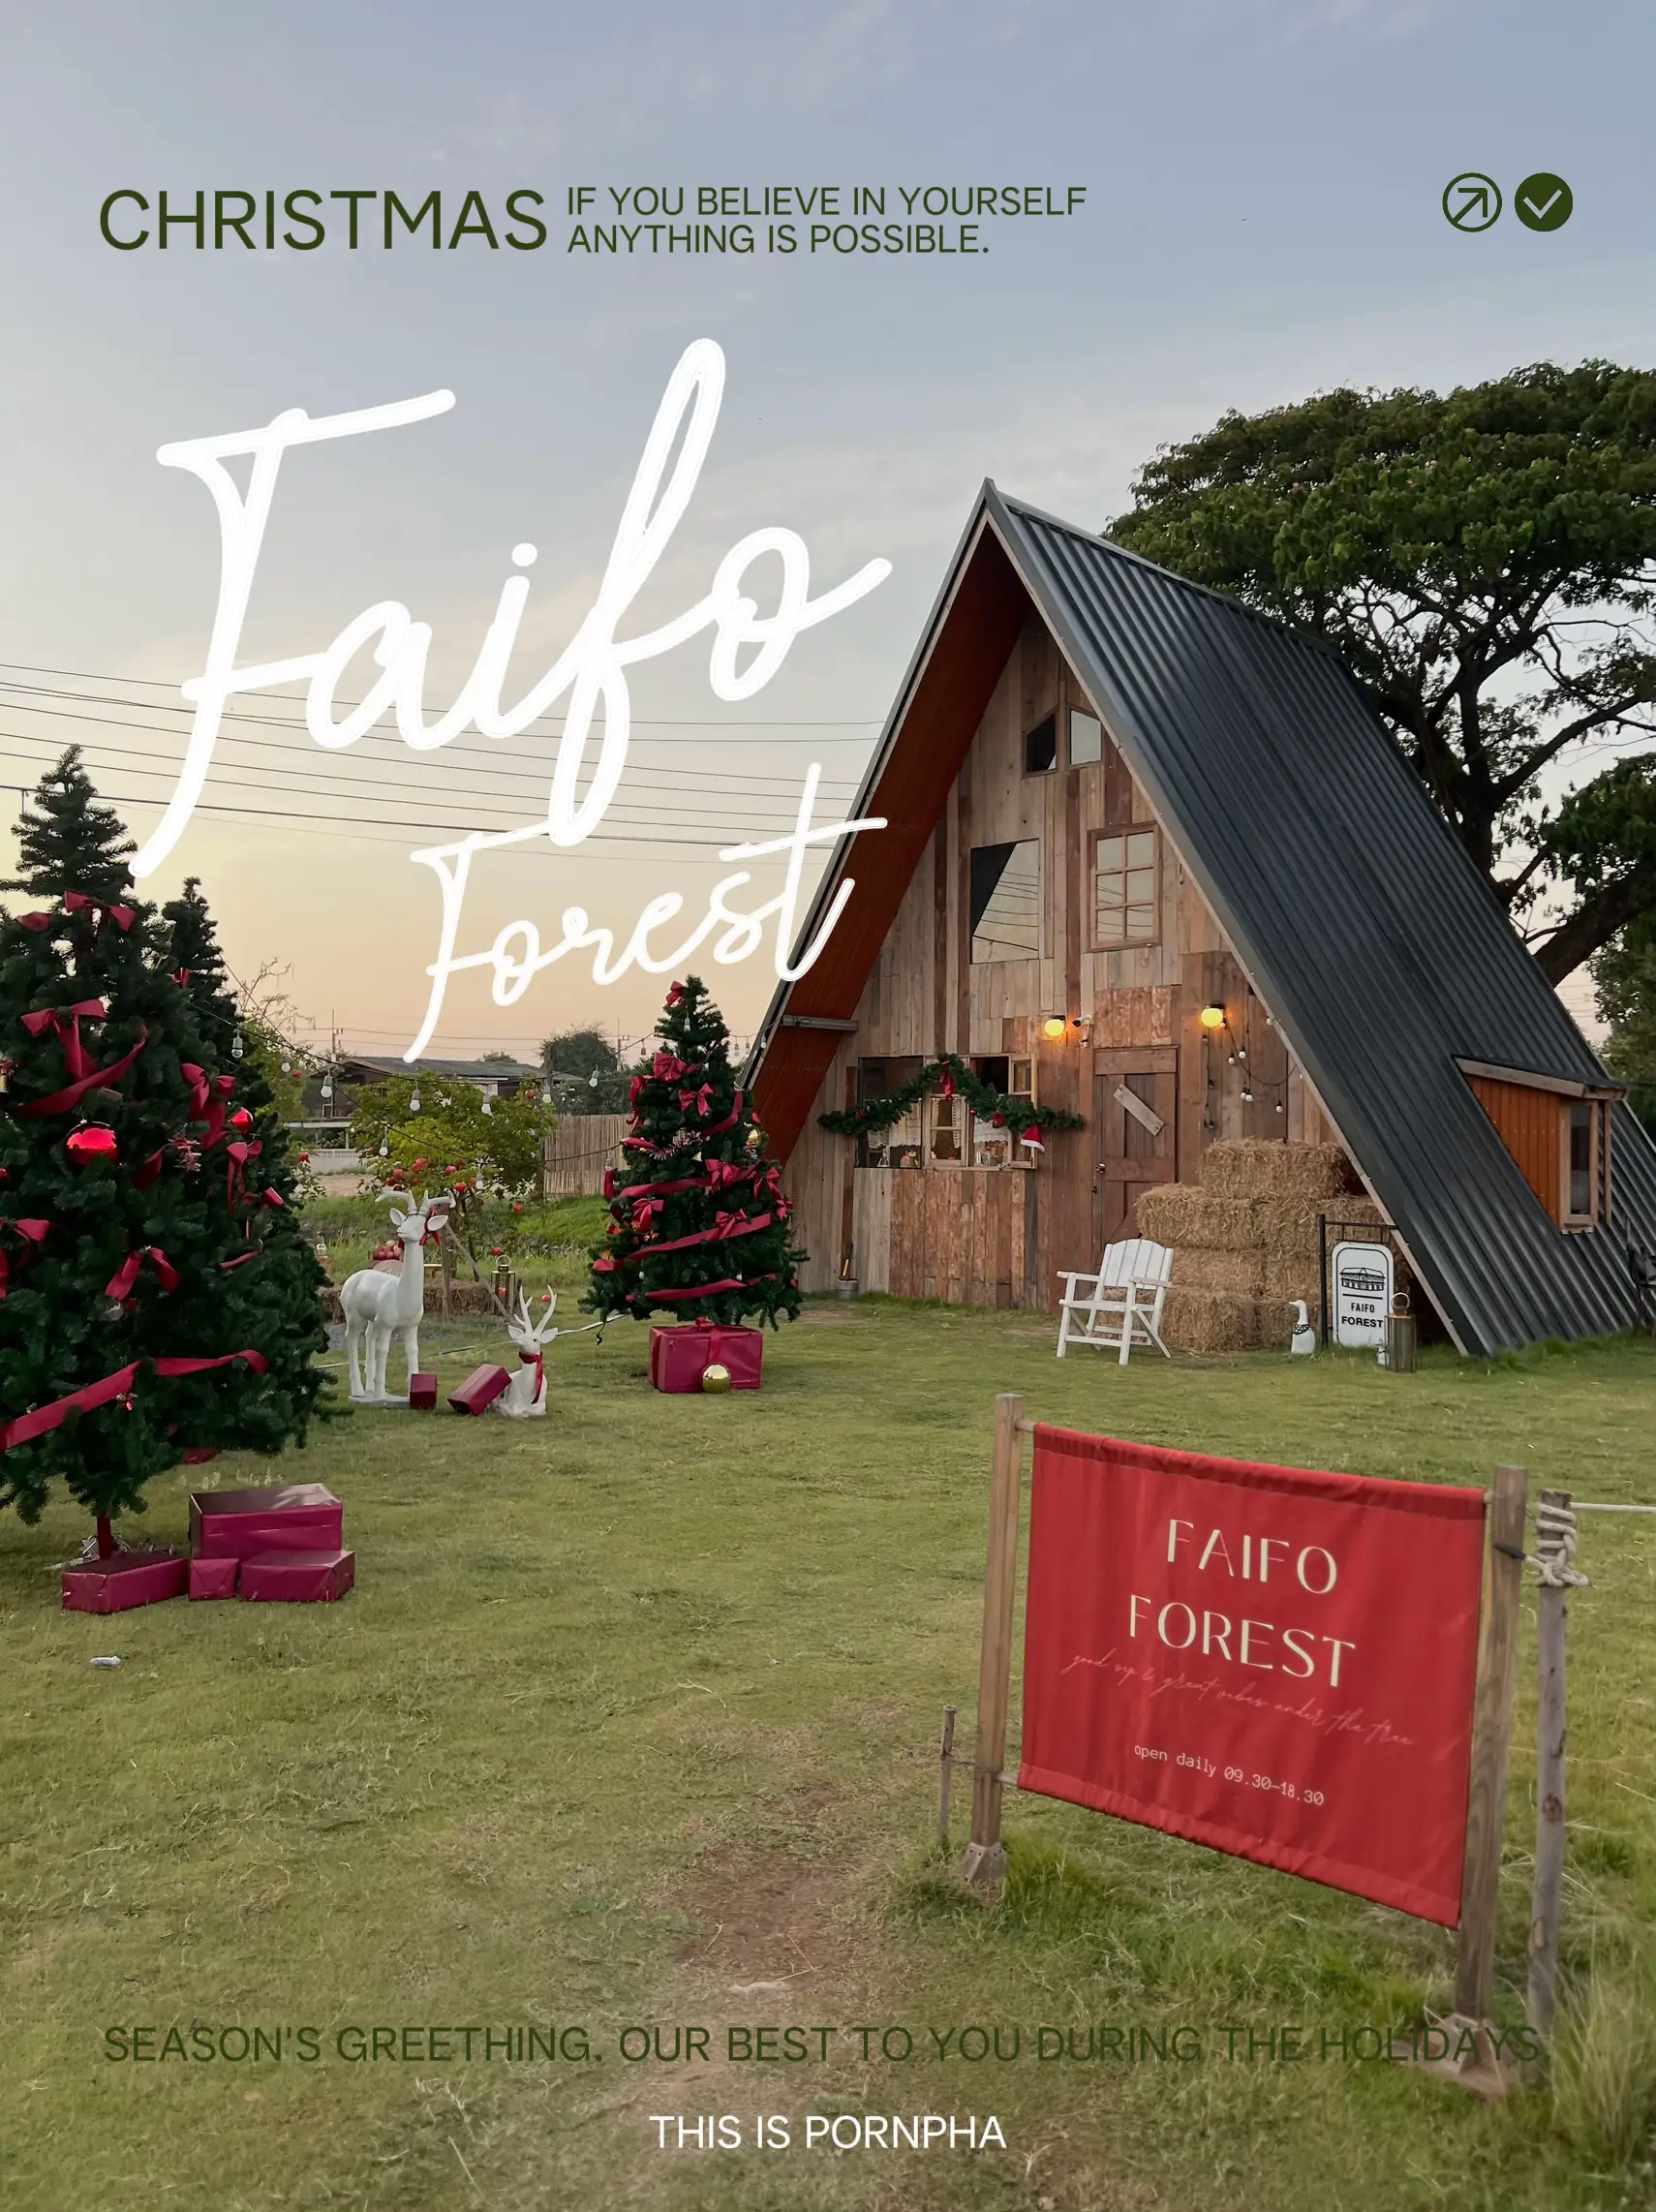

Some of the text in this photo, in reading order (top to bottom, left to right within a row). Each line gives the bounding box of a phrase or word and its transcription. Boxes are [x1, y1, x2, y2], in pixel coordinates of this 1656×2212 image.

[1341, 1315, 1384, 1328] FOREST
[1351, 1302, 1375, 1313] FAIFO
[1167, 1519, 1337, 1594] FAIFO
[1129, 1594, 1356, 1687] FOREST
[1059, 1647, 1117, 1675] good
[1149, 1673, 1222, 1701] great
[1325, 1708, 1365, 1735] the
[1134, 1745, 1168, 1762] open
[1176, 1753, 1216, 1778] daily
